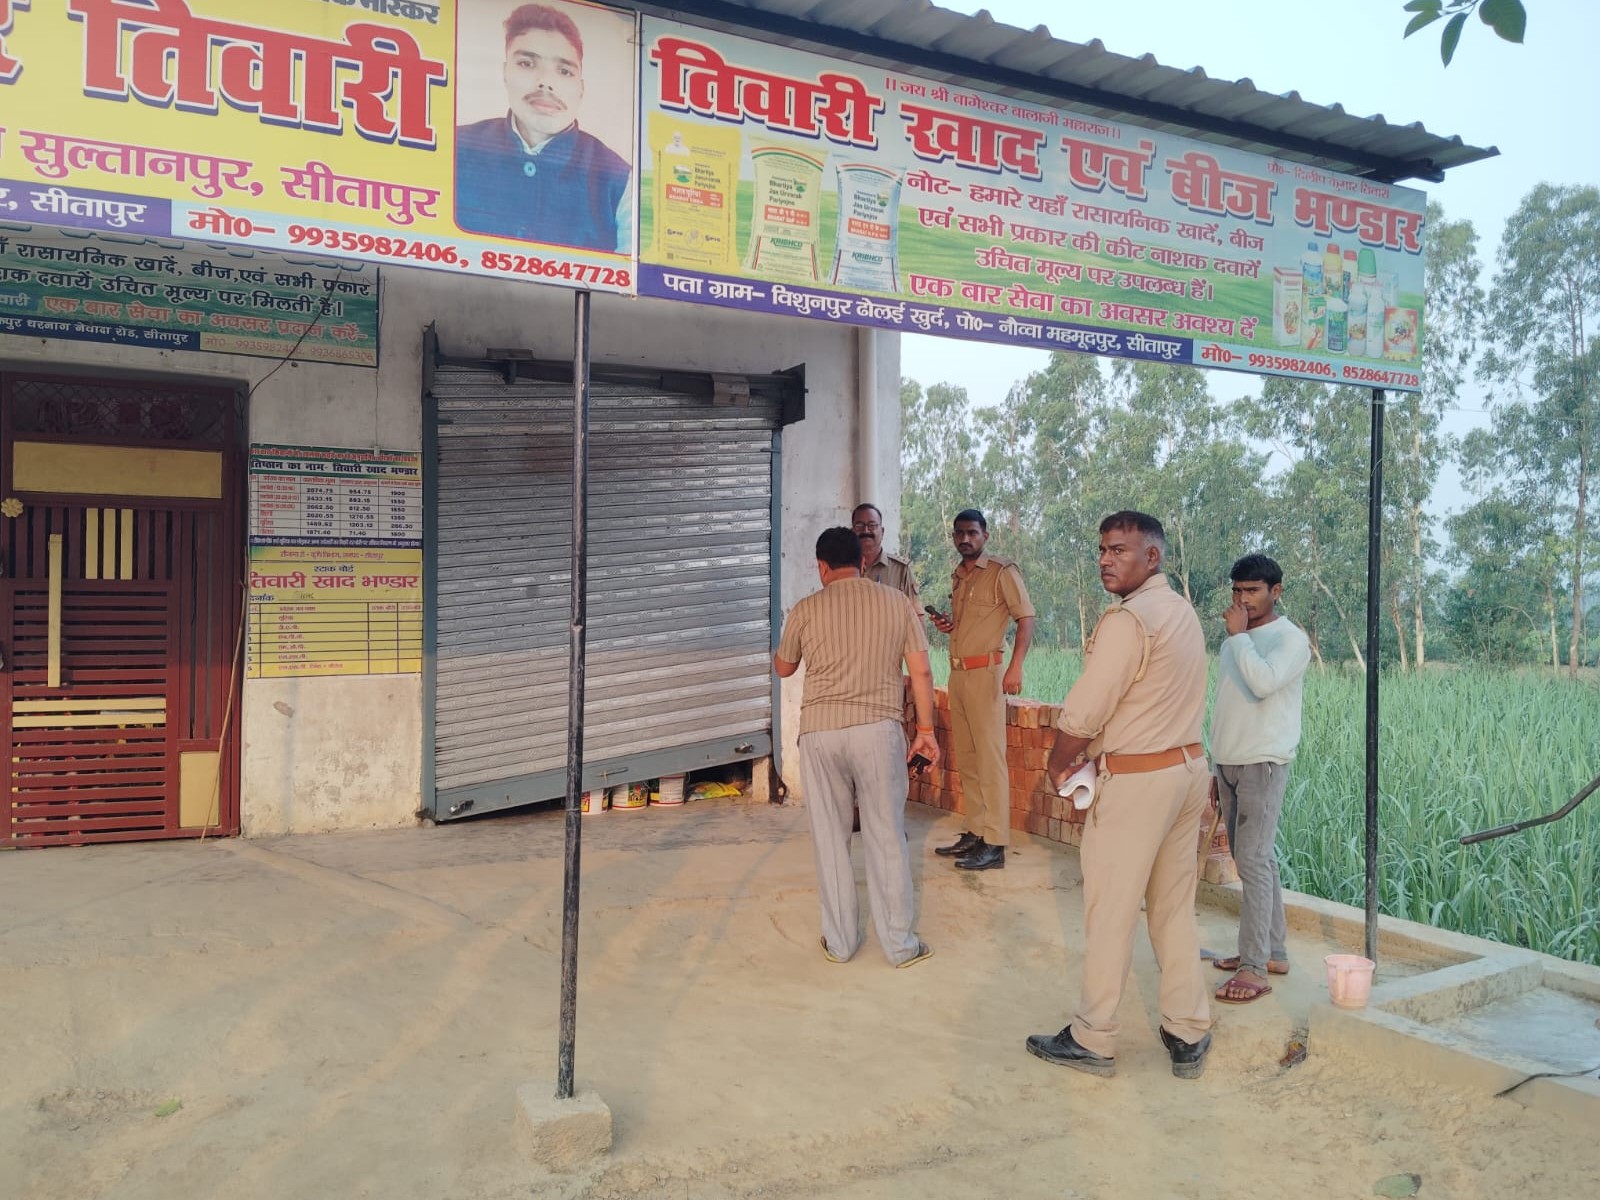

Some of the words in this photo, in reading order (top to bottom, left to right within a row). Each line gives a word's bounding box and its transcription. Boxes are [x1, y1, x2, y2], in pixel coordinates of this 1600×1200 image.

[67, 0, 447, 151] तिवारी
[931, 87, 948, 103] श्री
[649, 35, 886, 151] तिवारी
[900, 103, 1048, 183] खाद
[1060, 137, 1157, 203] एवं
[1164, 151, 1279, 227] बीज
[1293, 188, 1426, 256] भण्डार
[19, 130, 264, 198] सुल्तानपुर,
[280, 161, 440, 225] सीतापुर
[30, 187, 147, 227] सीतापुर
[969, 184, 1024, 208] हमारे
[1028, 194, 1069, 216] यहाँ
[1071, 203, 1171, 234] रासायनिक
[1229, 228, 1265, 251] बीज
[288, 224, 469, 268] 9935982406,
[481, 252, 631, 287] 8528647728
[919, 206, 955, 228] एवं
[958, 214, 1006, 237] सभी
[1010, 223, 1068, 248] प्रकार
[1071, 231, 1101, 253] की
[1105, 236, 1147, 259] कीट
[1150, 247, 1209, 270] नाशक
[16, 243, 127, 267] रासायनिक
[274, 272, 316, 290] सभी
[322, 278, 371, 296] प्रकार
[37, 270, 93, 289] दवायें
[101, 275, 158, 296] उचित
[165, 284, 212, 304] मूल्य
[218, 290, 246, 306] पर
[252, 290, 314, 312] मिलती
[975, 246, 1032, 273] उचित
[1036, 259, 1082, 284] मूल्य
[1087, 267, 1116, 286] पर
[1119, 272, 1186, 296] उपलब्ध
[44, 296, 80, 312] एक
[84, 300, 122, 318] बार
[127, 301, 171, 322] सेवा
[177, 309, 202, 327] का
[210, 313, 272, 333] अवसर
[663, 272, 704, 295] पता
[770, 284, 853, 319] विशुनपुर
[1126, 333, 1182, 359] सीतापुर
[910, 275, 955, 297] एक
[961, 282, 1003, 305] बार
[1007, 284, 1055, 312] सेवा
[1060, 296, 1093, 317] का
[1098, 302, 1168, 328] अवसर
[1172, 312, 1235, 336] अवश्य
[1239, 317, 1259, 340] दें
[143, 328, 189, 345] सीतापुर
[1248, 353, 1336, 379] 9935982406,
[1342, 365, 1419, 387] 8528647728
[312, 575, 356, 589] खाद
[361, 575, 421, 589] भण्डार
